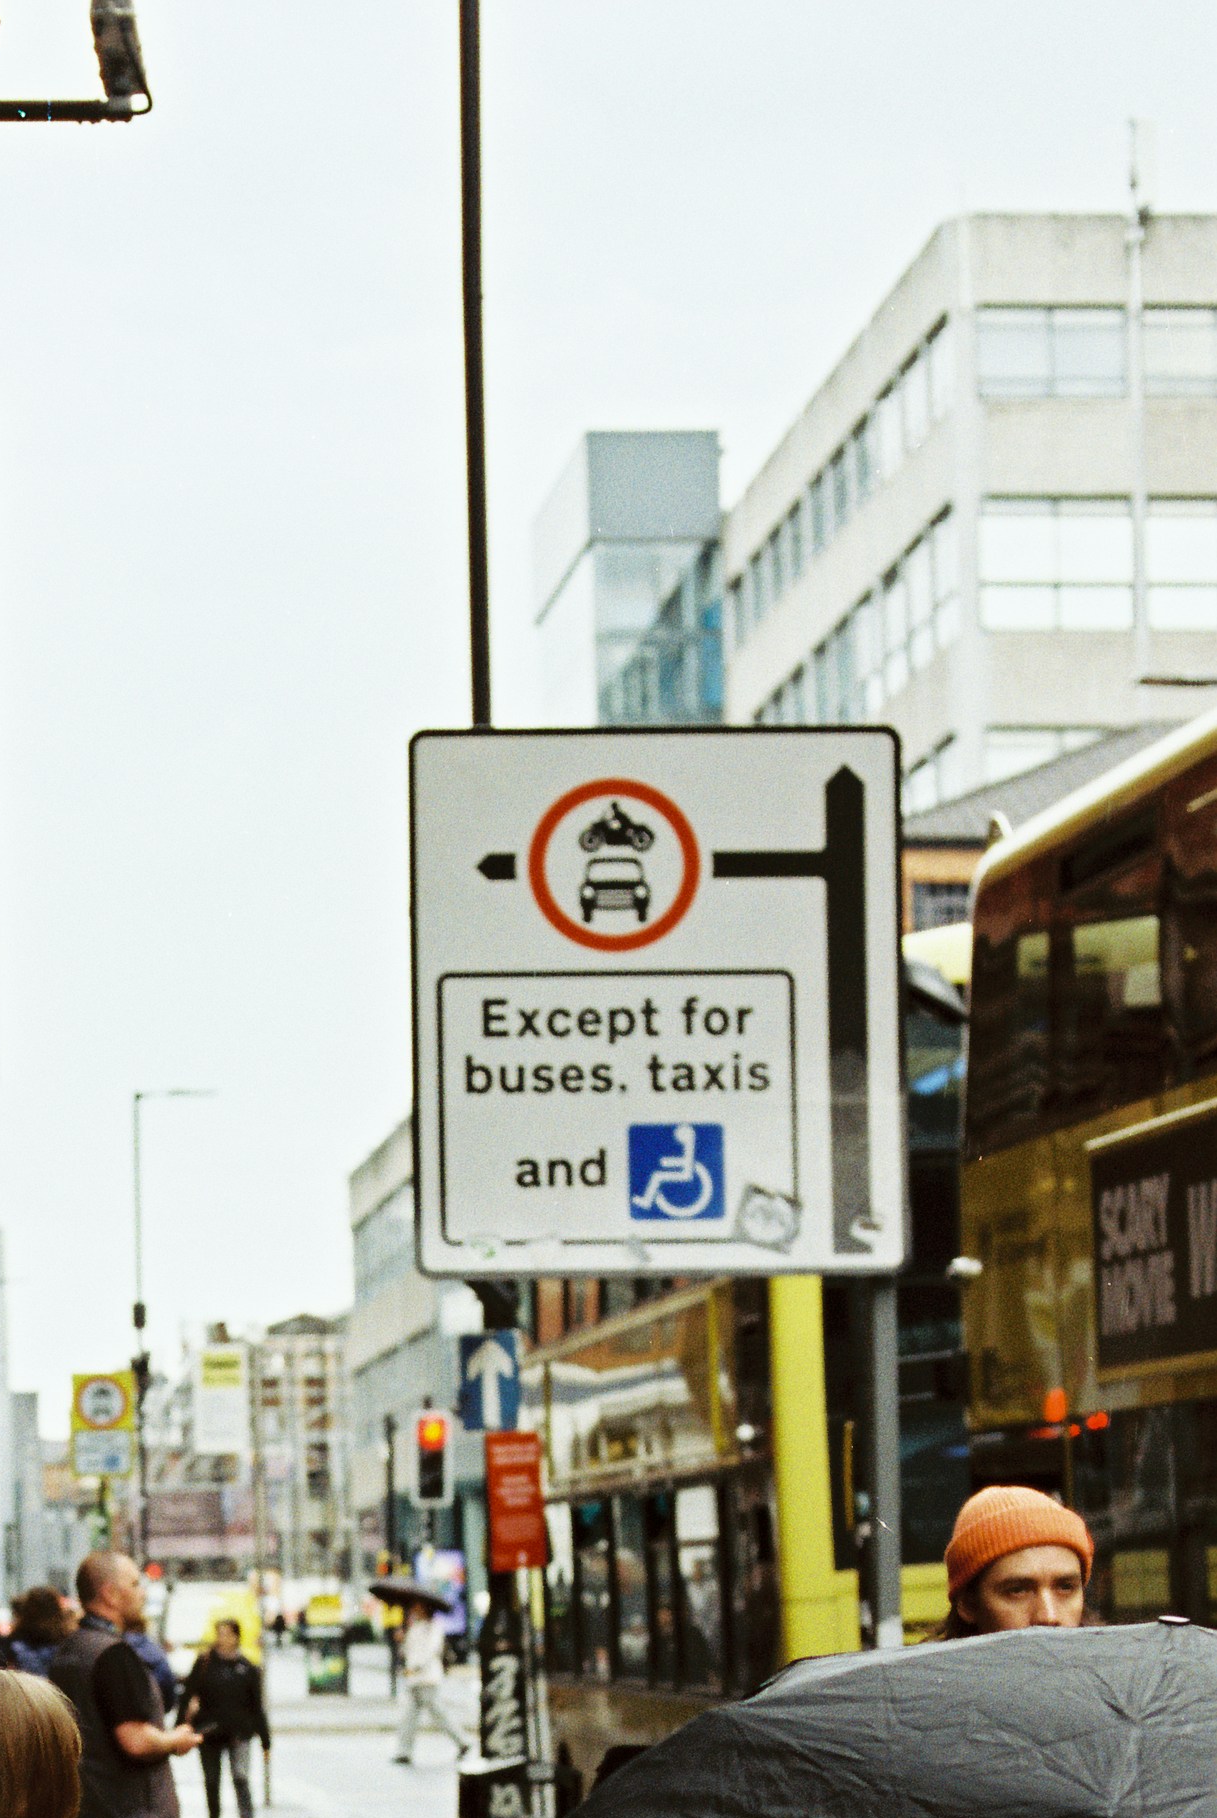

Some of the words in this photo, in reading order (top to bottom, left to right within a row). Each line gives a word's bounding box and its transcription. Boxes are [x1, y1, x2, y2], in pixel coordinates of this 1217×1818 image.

[481, 997, 660, 1045] Except
[681, 996, 754, 1037] for
[647, 1052, 771, 1093] taxis
[515, 1148, 607, 1189] and
